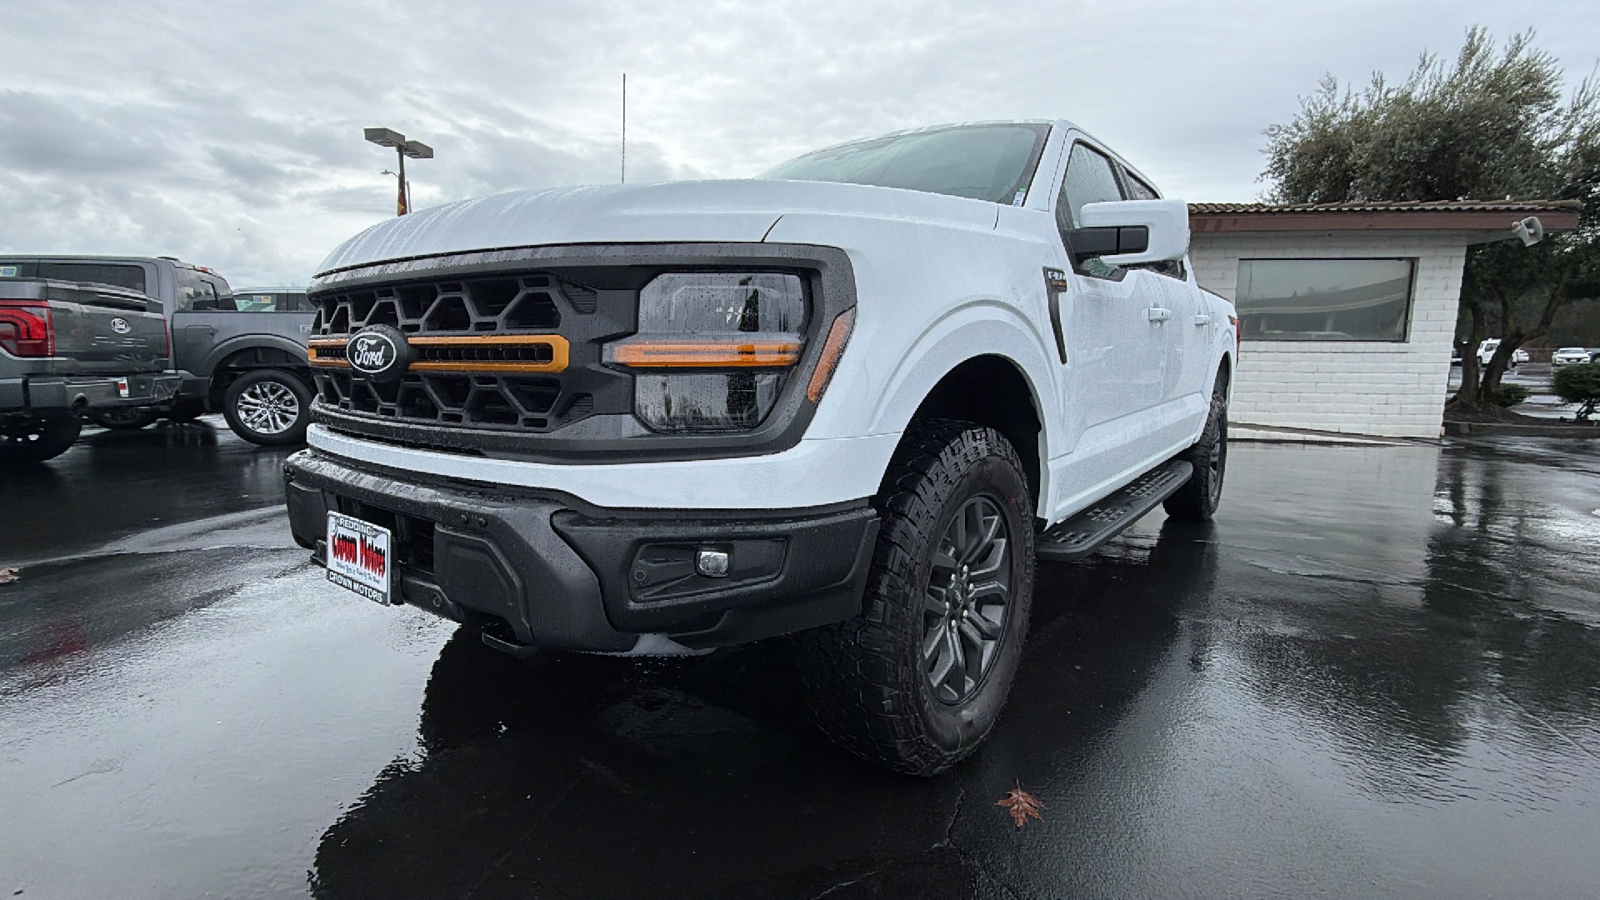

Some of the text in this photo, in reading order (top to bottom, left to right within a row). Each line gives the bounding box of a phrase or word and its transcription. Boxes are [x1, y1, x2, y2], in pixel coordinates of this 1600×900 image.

[355, 338, 385, 366] Ford
[330, 572, 352, 590] CROWN
[353, 581, 383, 603] MOTORS
